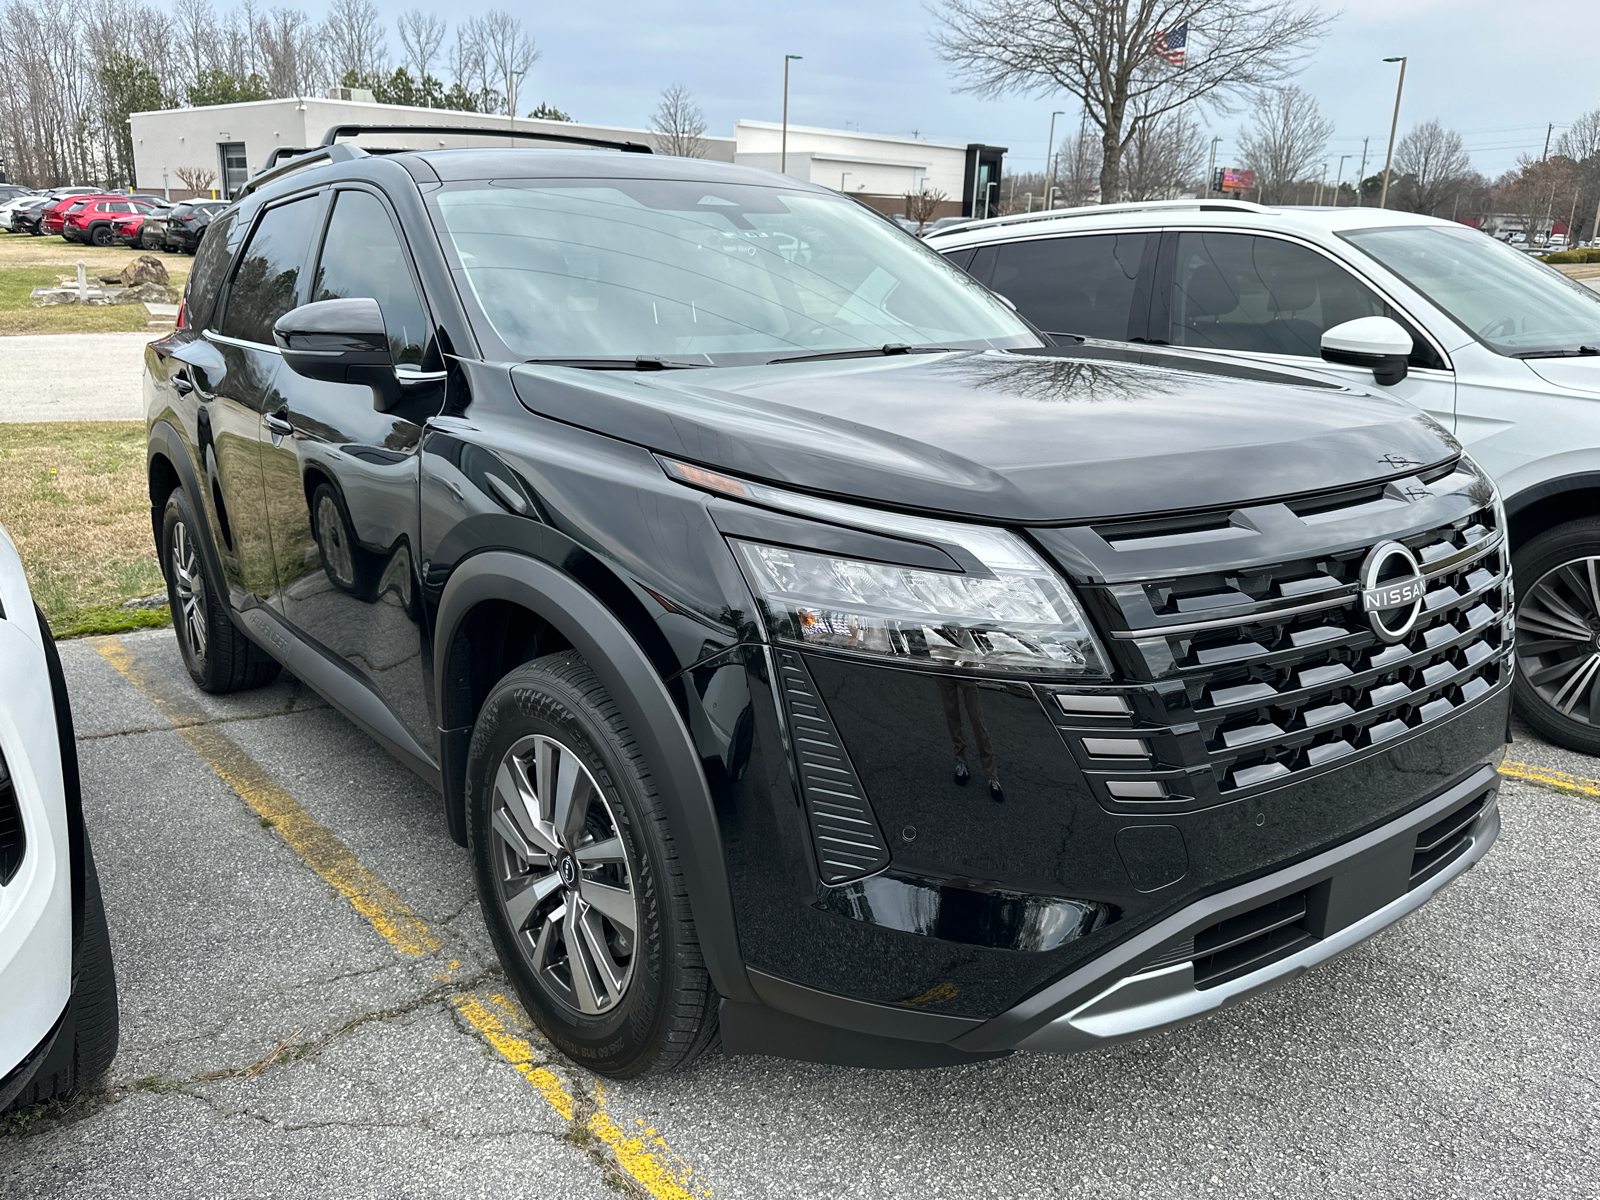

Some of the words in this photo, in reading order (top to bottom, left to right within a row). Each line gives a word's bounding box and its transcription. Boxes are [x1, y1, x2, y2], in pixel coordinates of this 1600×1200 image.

[1366, 581, 1426, 609] NISSAN
[580, 1046, 597, 1059] R18
[598, 1036, 624, 1058] 255/60
